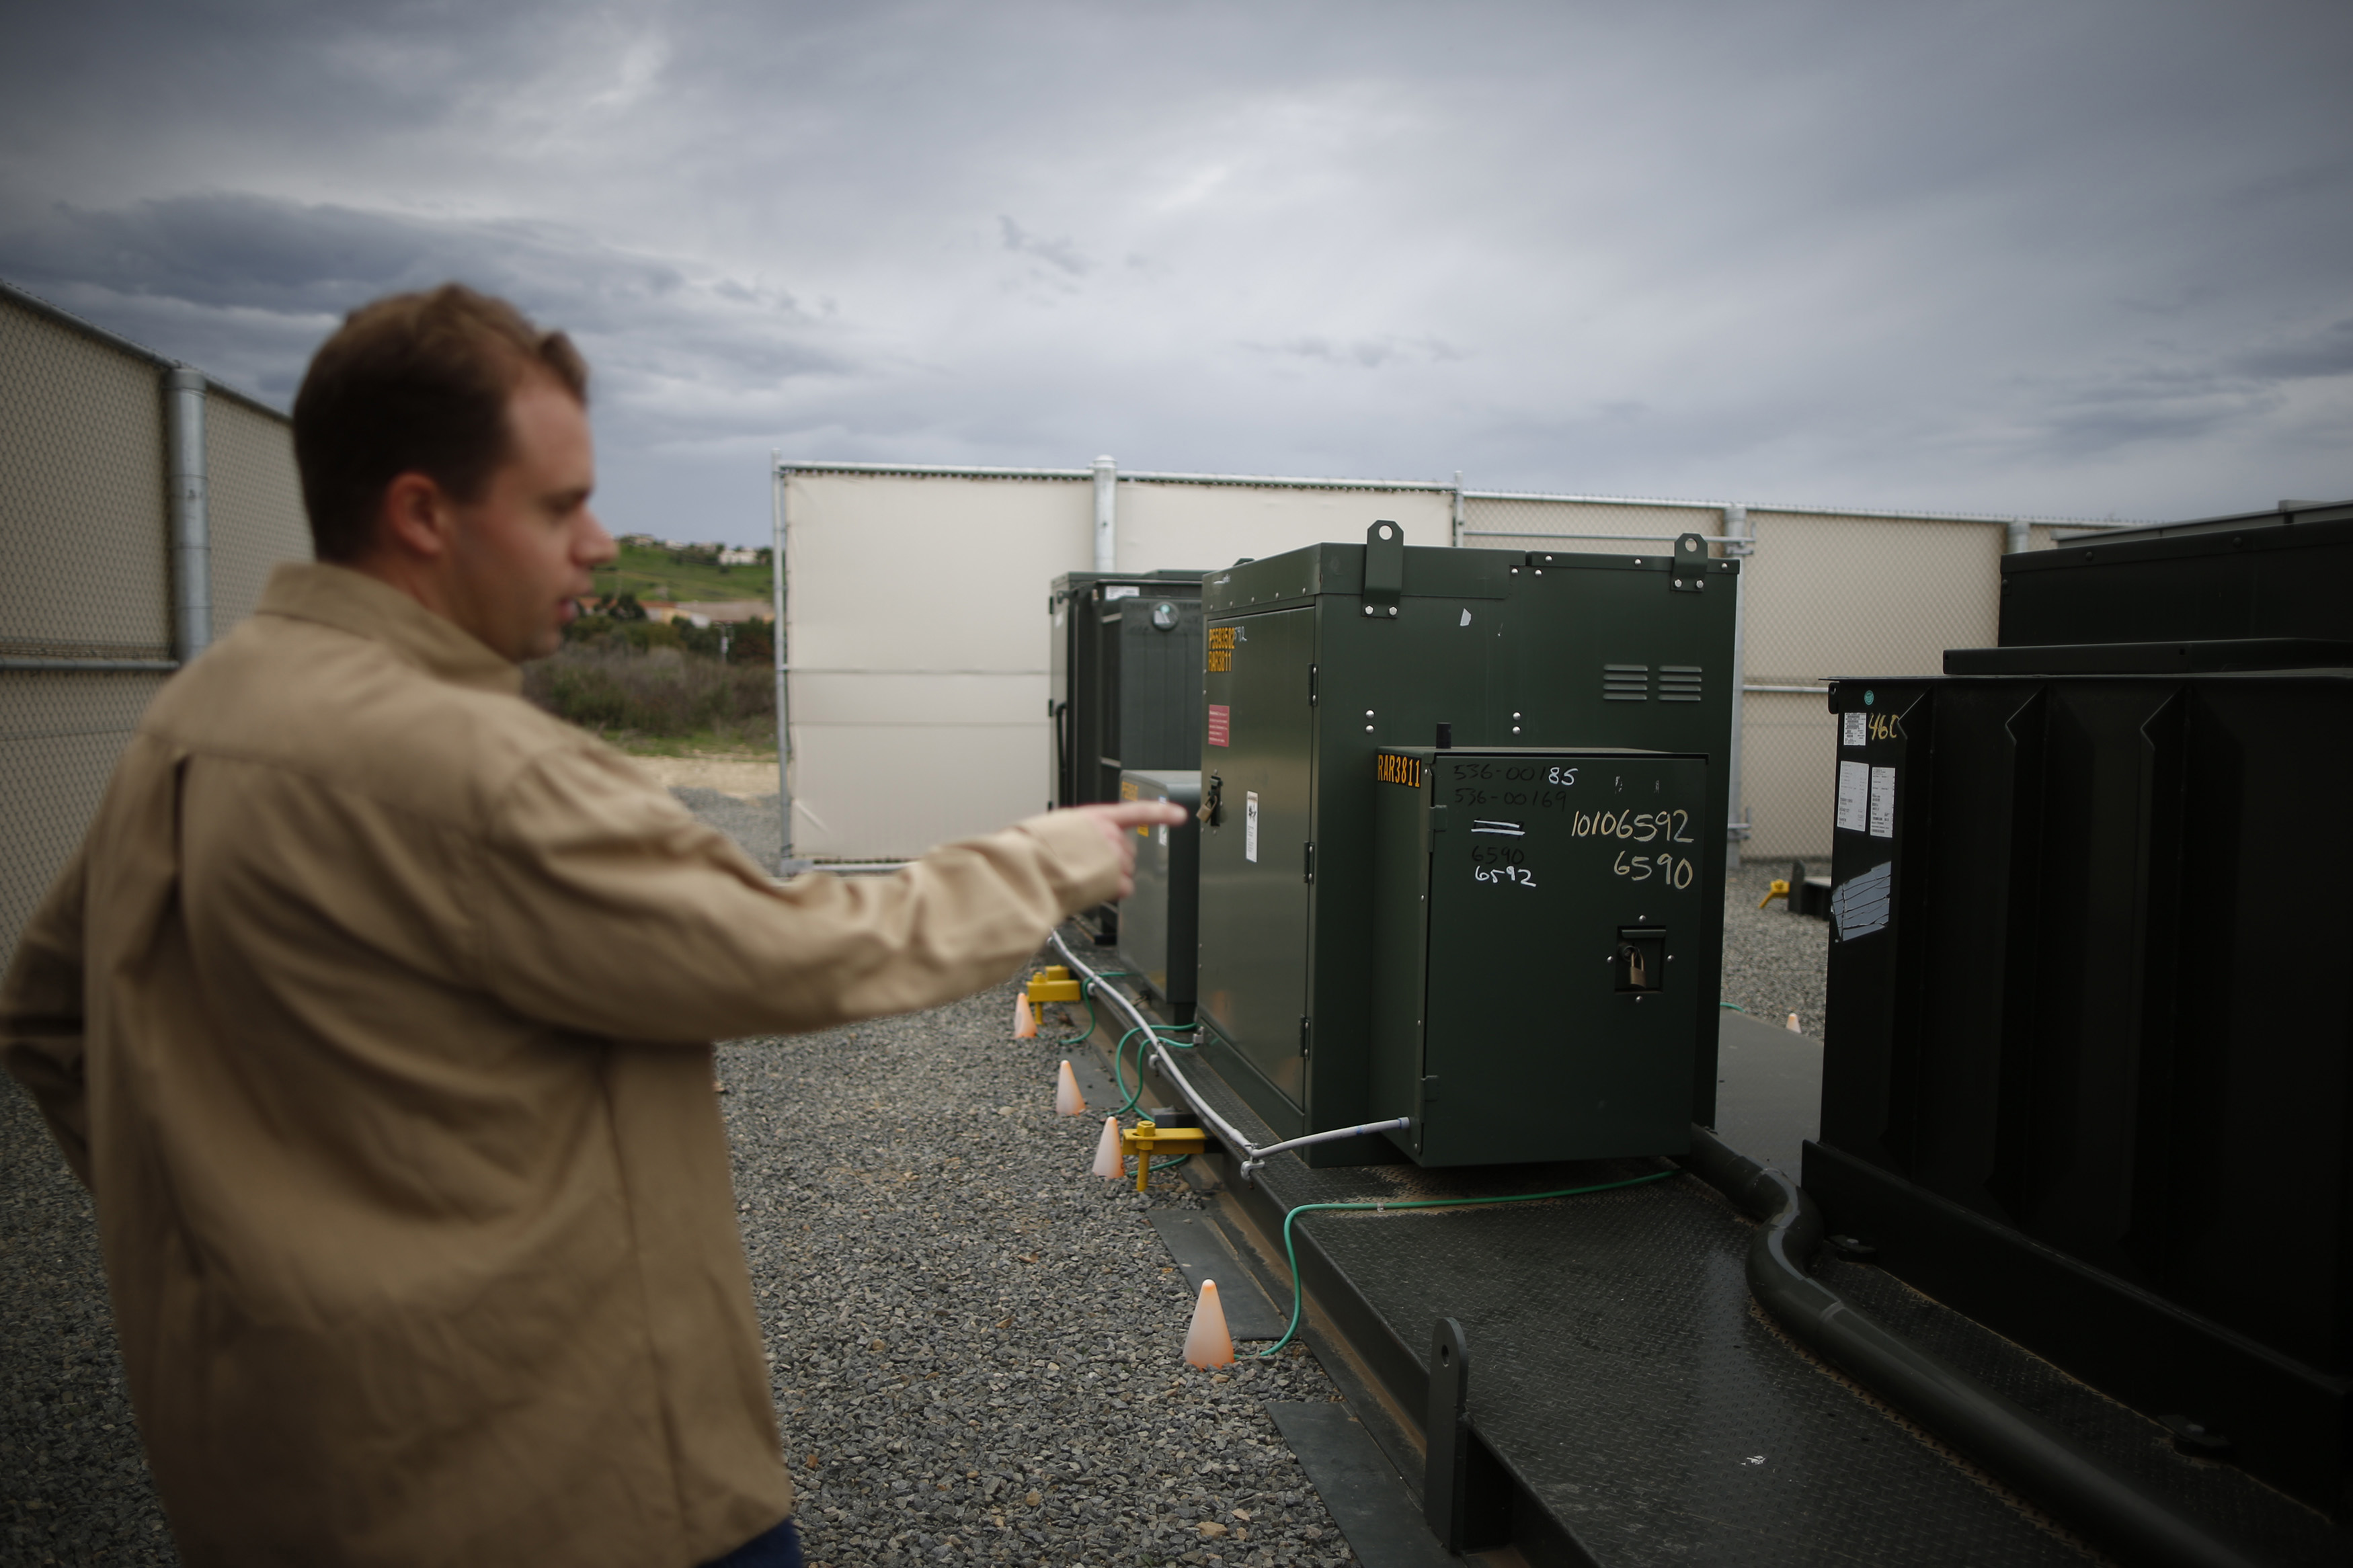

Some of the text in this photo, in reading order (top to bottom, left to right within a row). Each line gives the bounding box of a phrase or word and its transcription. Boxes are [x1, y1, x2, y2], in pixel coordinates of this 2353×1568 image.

[1208, 650, 1232, 672] RAR3811
[1378, 754, 1420, 788] RAR3811
[1454, 788, 1567, 812] 536-00169
[1571, 809, 1693, 843] 10106592
[1471, 845, 1525, 865] 6590
[1475, 866, 1537, 887] 6592
[1613, 850, 1693, 889] 6590
